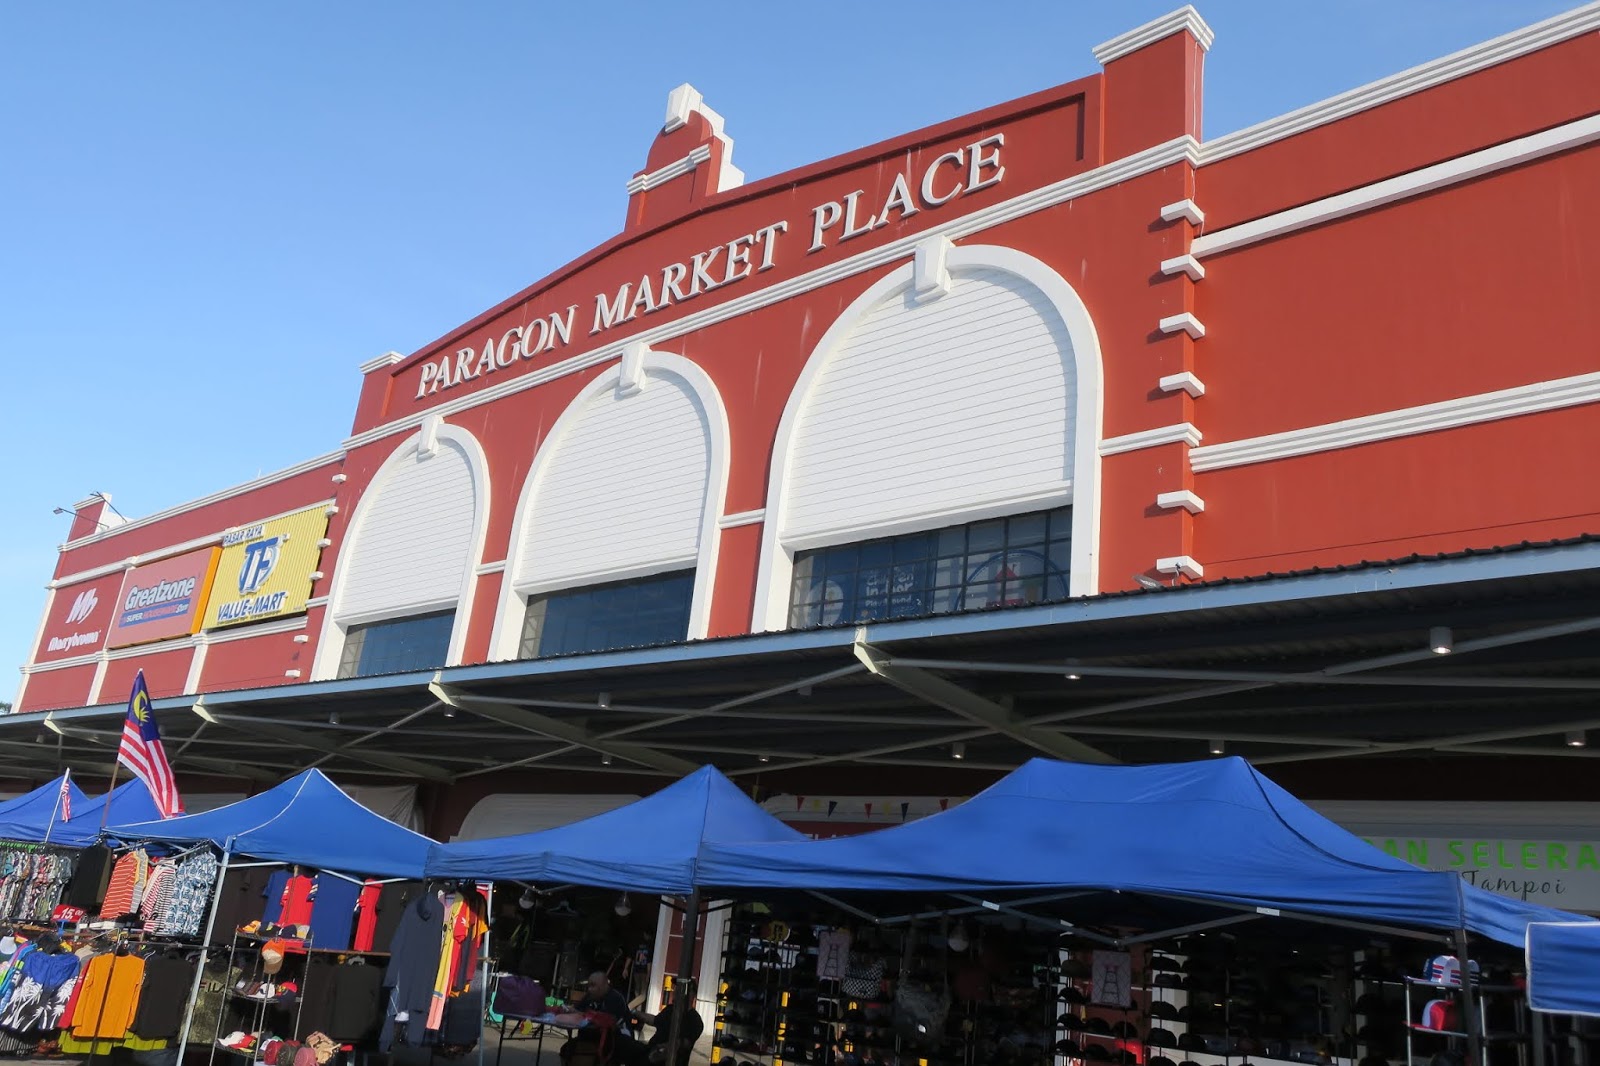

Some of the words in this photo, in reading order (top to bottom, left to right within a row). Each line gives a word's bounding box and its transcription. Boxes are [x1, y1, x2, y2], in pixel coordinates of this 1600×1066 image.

[415, 303, 580, 400] PARAGON
[589, 220, 789, 336] MARKET
[807, 132, 1007, 254] PLACE
[245, 525, 263, 538] RAYA
[124, 576, 196, 611] Greatzone
[126, 612, 144, 623] SUPER
[1362, 837, 1428, 865] AN
[1449, 839, 1600, 871] SELERA
[1461, 869, 1567, 901] Tampoi
